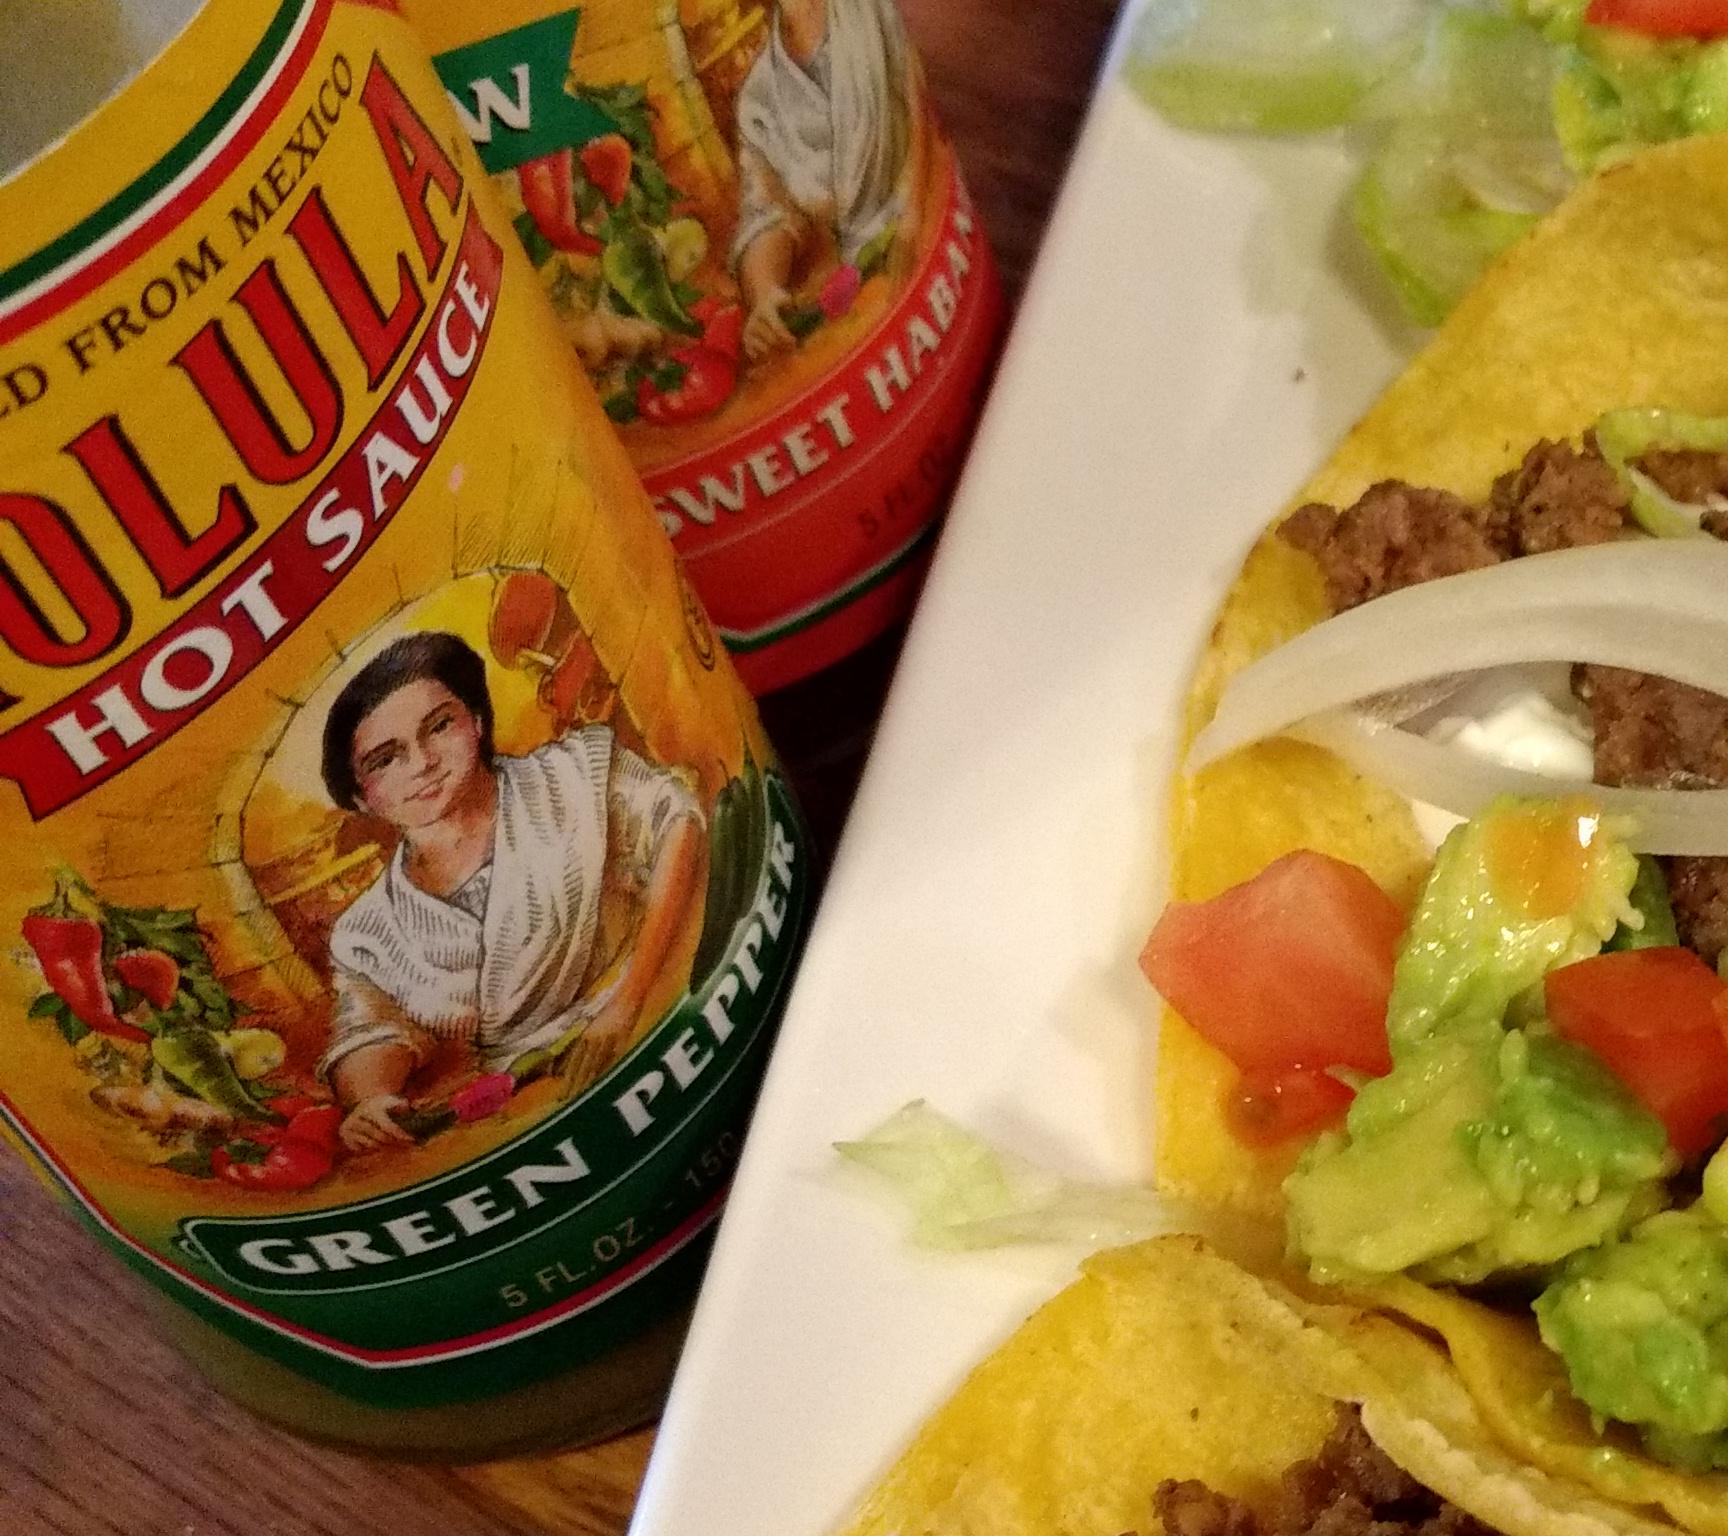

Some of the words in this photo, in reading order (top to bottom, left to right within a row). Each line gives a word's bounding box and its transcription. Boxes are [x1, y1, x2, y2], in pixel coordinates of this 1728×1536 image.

[0, 362, 48, 417] D
[65, 234, 228, 375] FROM
[226, 53, 353, 248] MEXICO
[0, 48, 465, 712] OLULA
[43, 558, 290, 777] HOT
[304, 262, 491, 573] SAUCE
[654, 393, 857, 540] SWEET
[238, 1135, 592, 1277] GREEN
[610, 819, 797, 1138] PEPPER
[500, 1283, 529, 1309] 5
